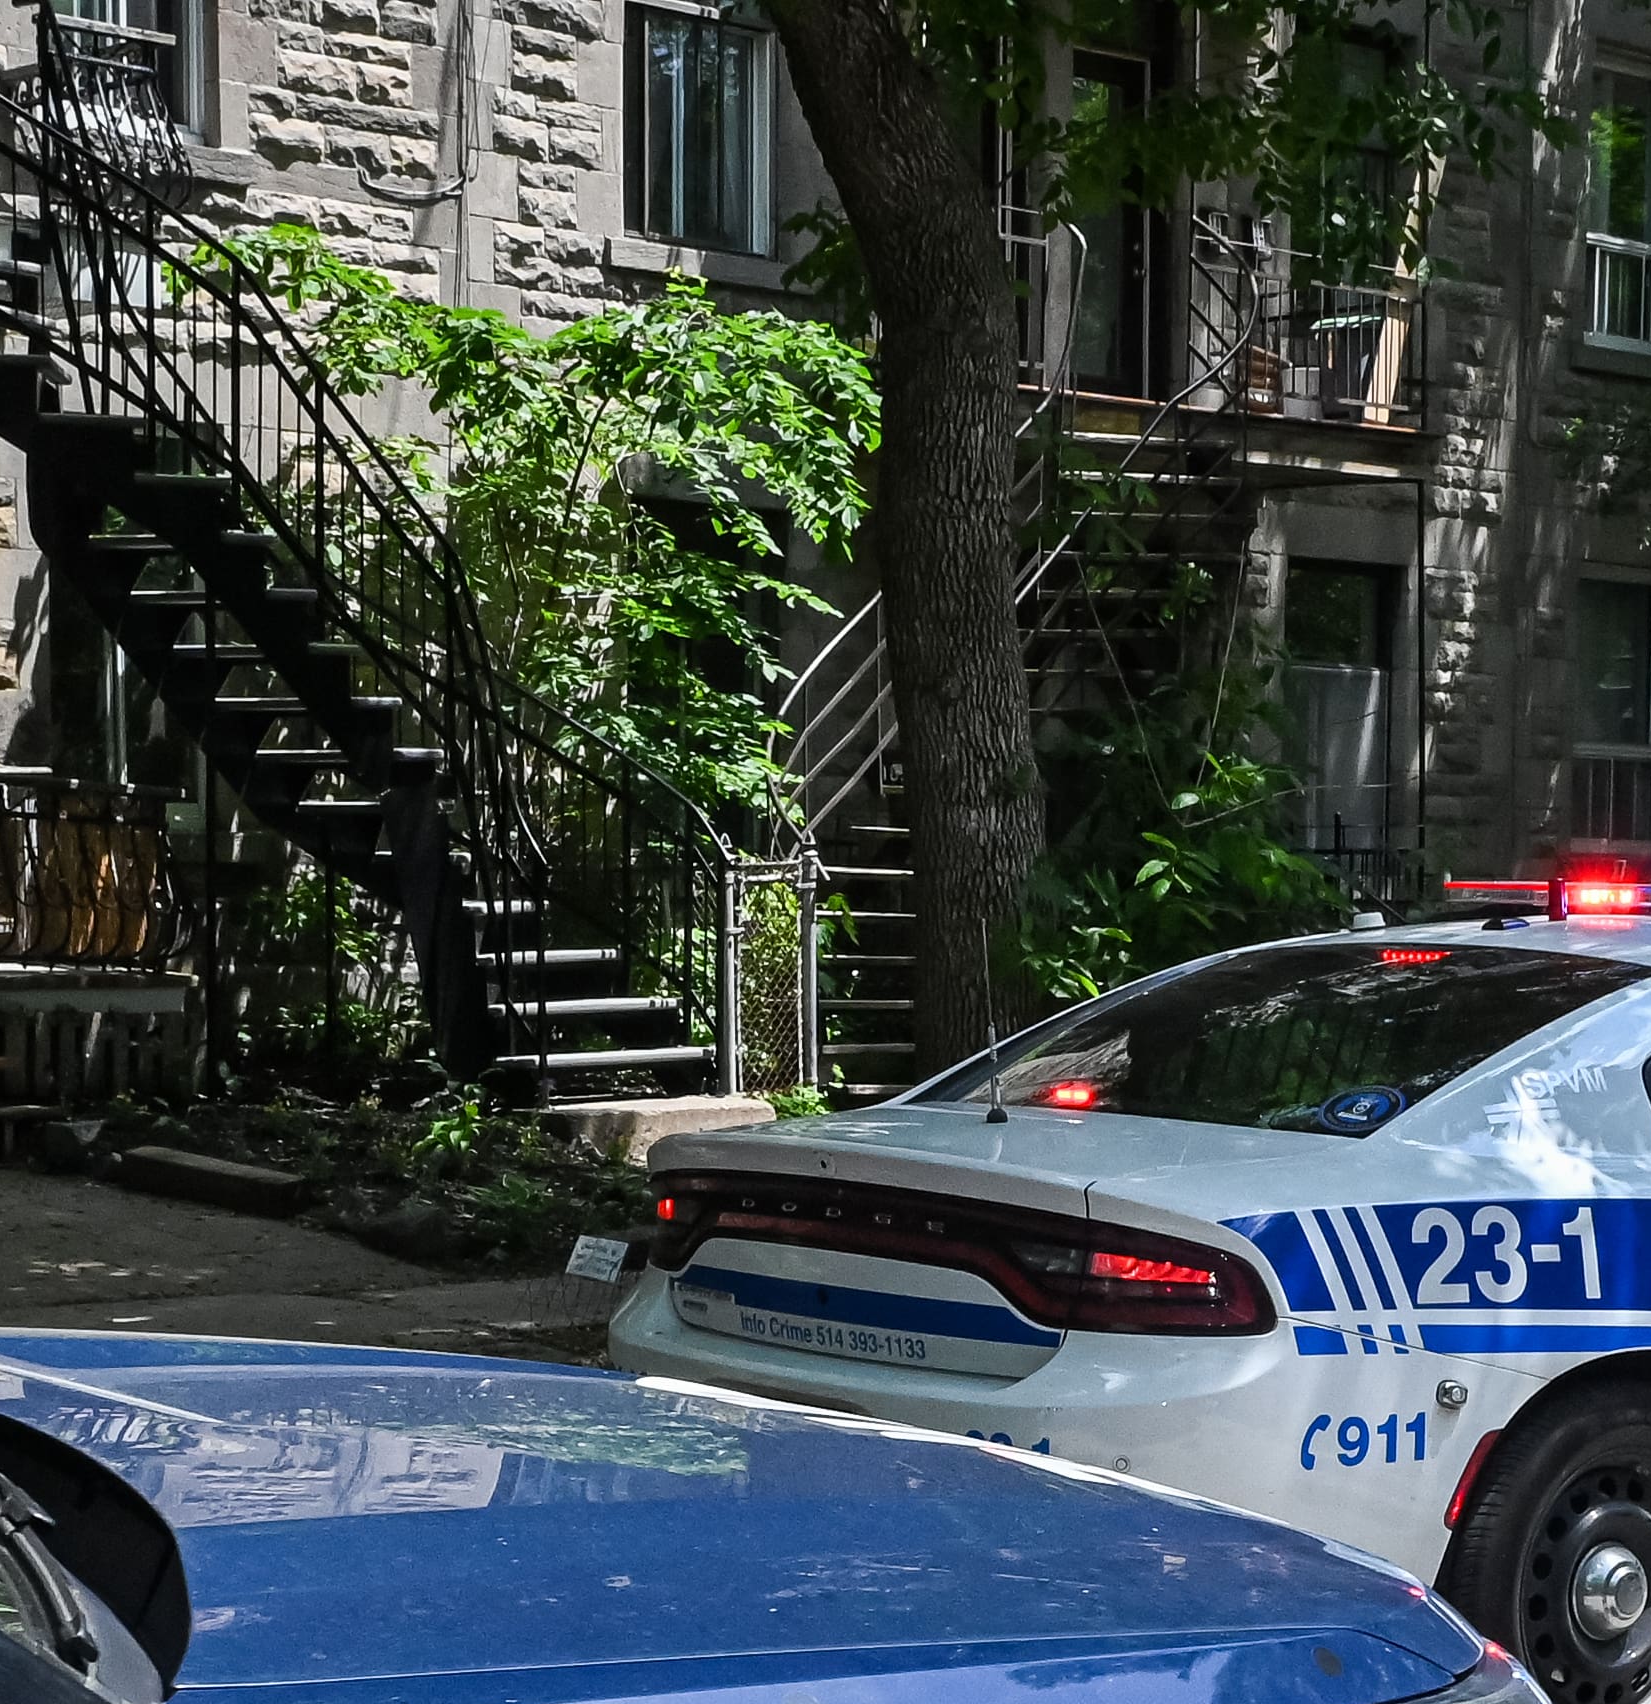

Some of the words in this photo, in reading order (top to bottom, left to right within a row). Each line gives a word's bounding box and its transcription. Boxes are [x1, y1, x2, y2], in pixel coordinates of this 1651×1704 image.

[1520, 1067, 1609, 1099] SPVM
[740, 1197, 948, 1234] DODGE
[1411, 1204, 1602, 1306] 23-1
[739, 1312, 767, 1335] Info
[769, 1316, 812, 1344] Crime
[815, 1324, 844, 1351] 514
[848, 1331, 927, 1361] 393-1133
[1335, 1411, 1428, 1467] 911
